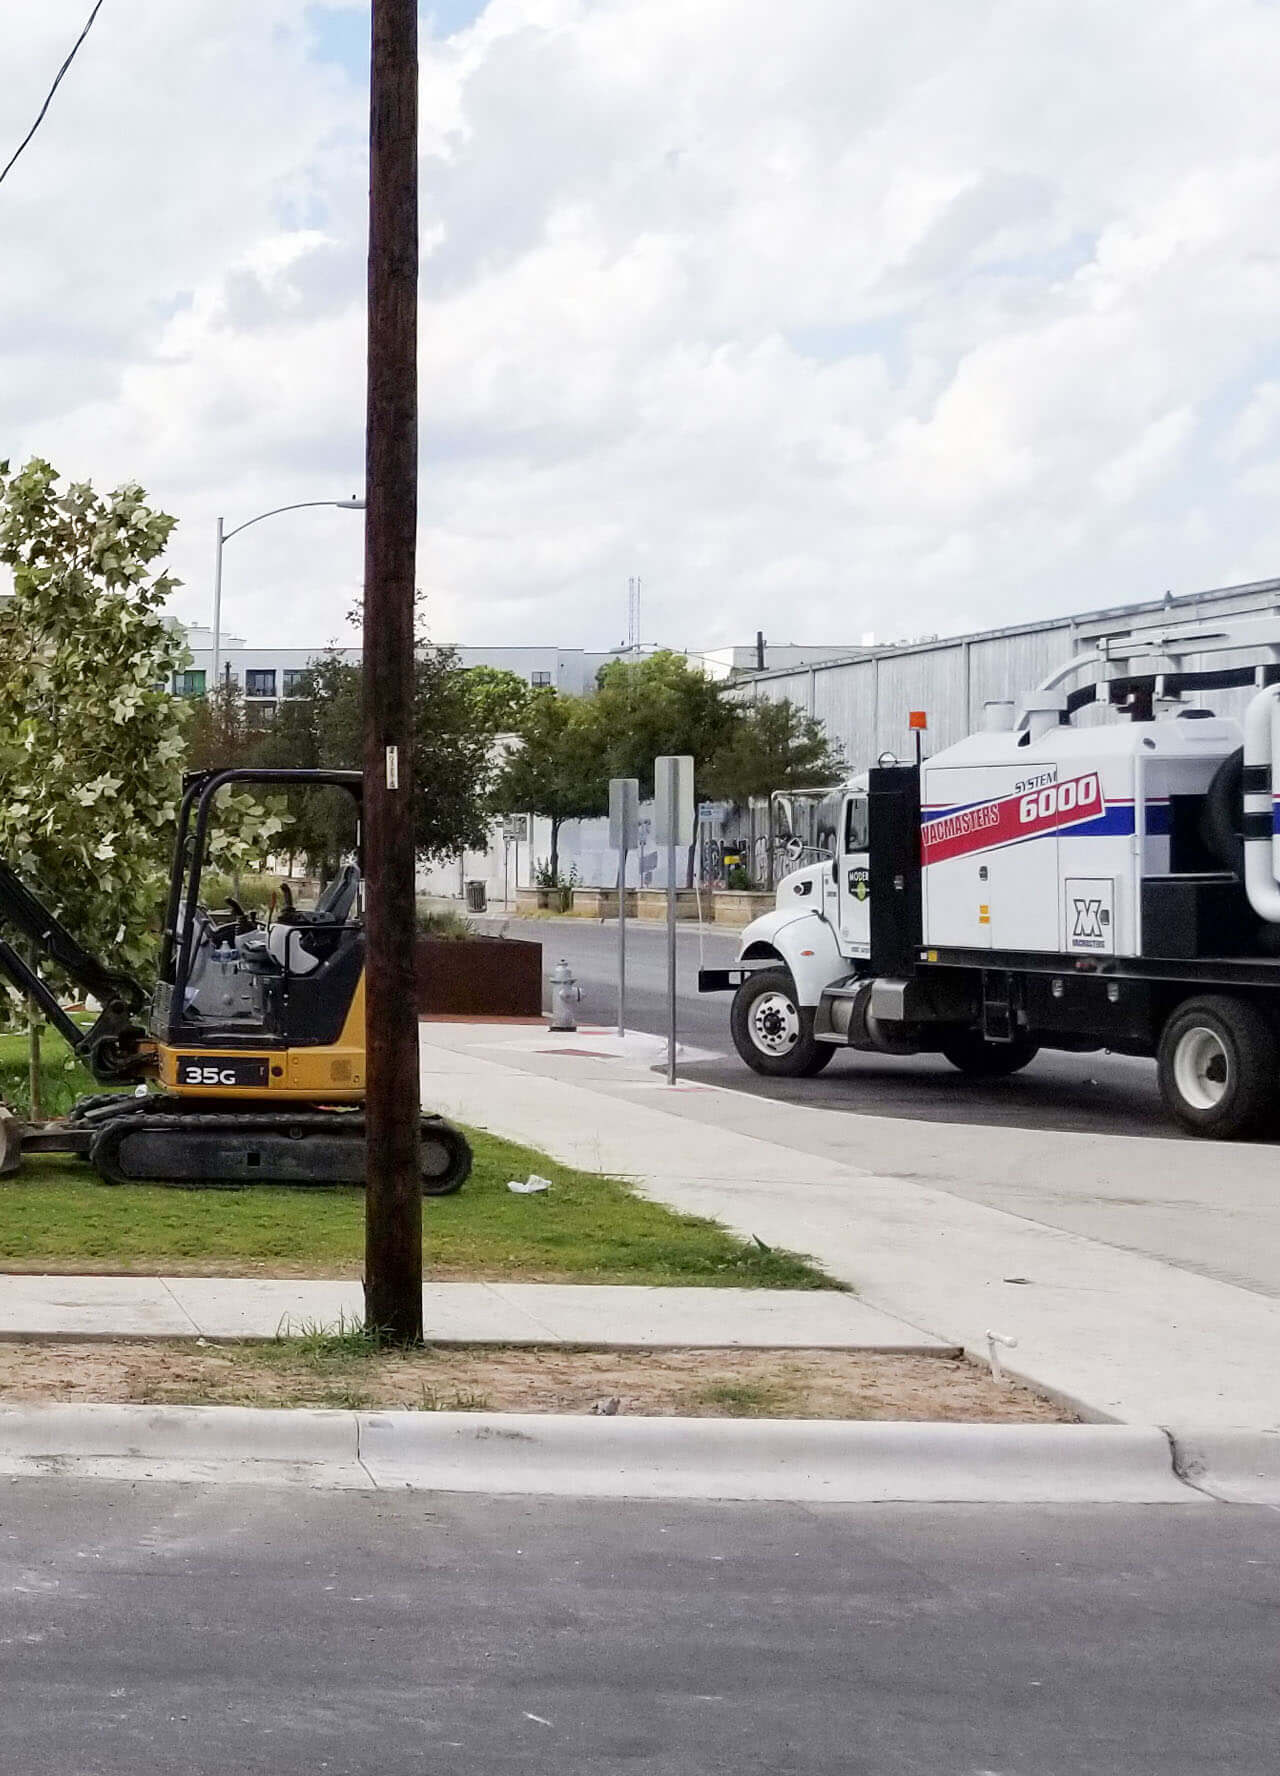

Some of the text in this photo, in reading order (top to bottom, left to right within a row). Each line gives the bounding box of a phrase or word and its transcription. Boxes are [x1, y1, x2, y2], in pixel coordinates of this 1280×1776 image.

[1014, 771, 1057, 794] SYSTEM
[921, 775, 1098, 846] VACMASTERS 6000
[185, 1067, 236, 1085] 35G
